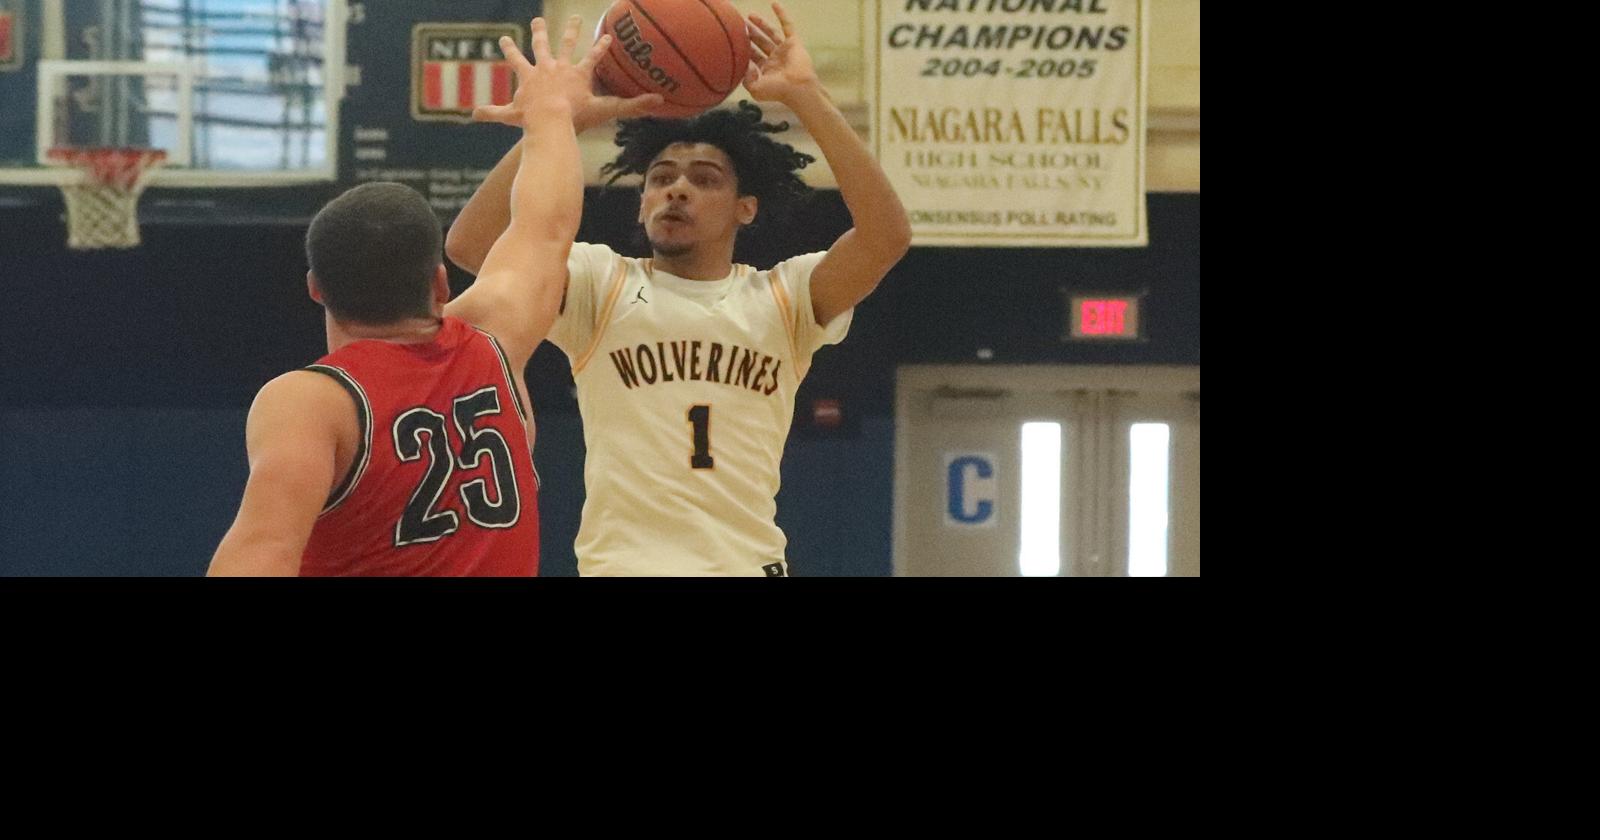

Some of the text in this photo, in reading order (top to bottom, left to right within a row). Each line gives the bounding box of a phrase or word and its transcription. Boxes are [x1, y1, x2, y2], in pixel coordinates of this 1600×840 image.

[905, 0, 1108, 13] NATIONAL
[430, 39, 501, 58] NFL
[614, 9, 680, 93] Wilson
[887, 25, 1130, 51] CHAMPIONS
[919, 58, 1099, 79] 2004-2005
[887, 106, 1130, 145] NIAGARA FALLS
[904, 152, 1102, 168] HIGH SCHOOL
[908, 210, 1118, 226] ONSENSUS POLL RATING
[1080, 299, 1129, 335] EXIT
[609, 340, 782, 397] WOLVERINES
[685, 402, 715, 472] 1
[392, 384, 521, 548] 25
[946, 455, 994, 525] C
